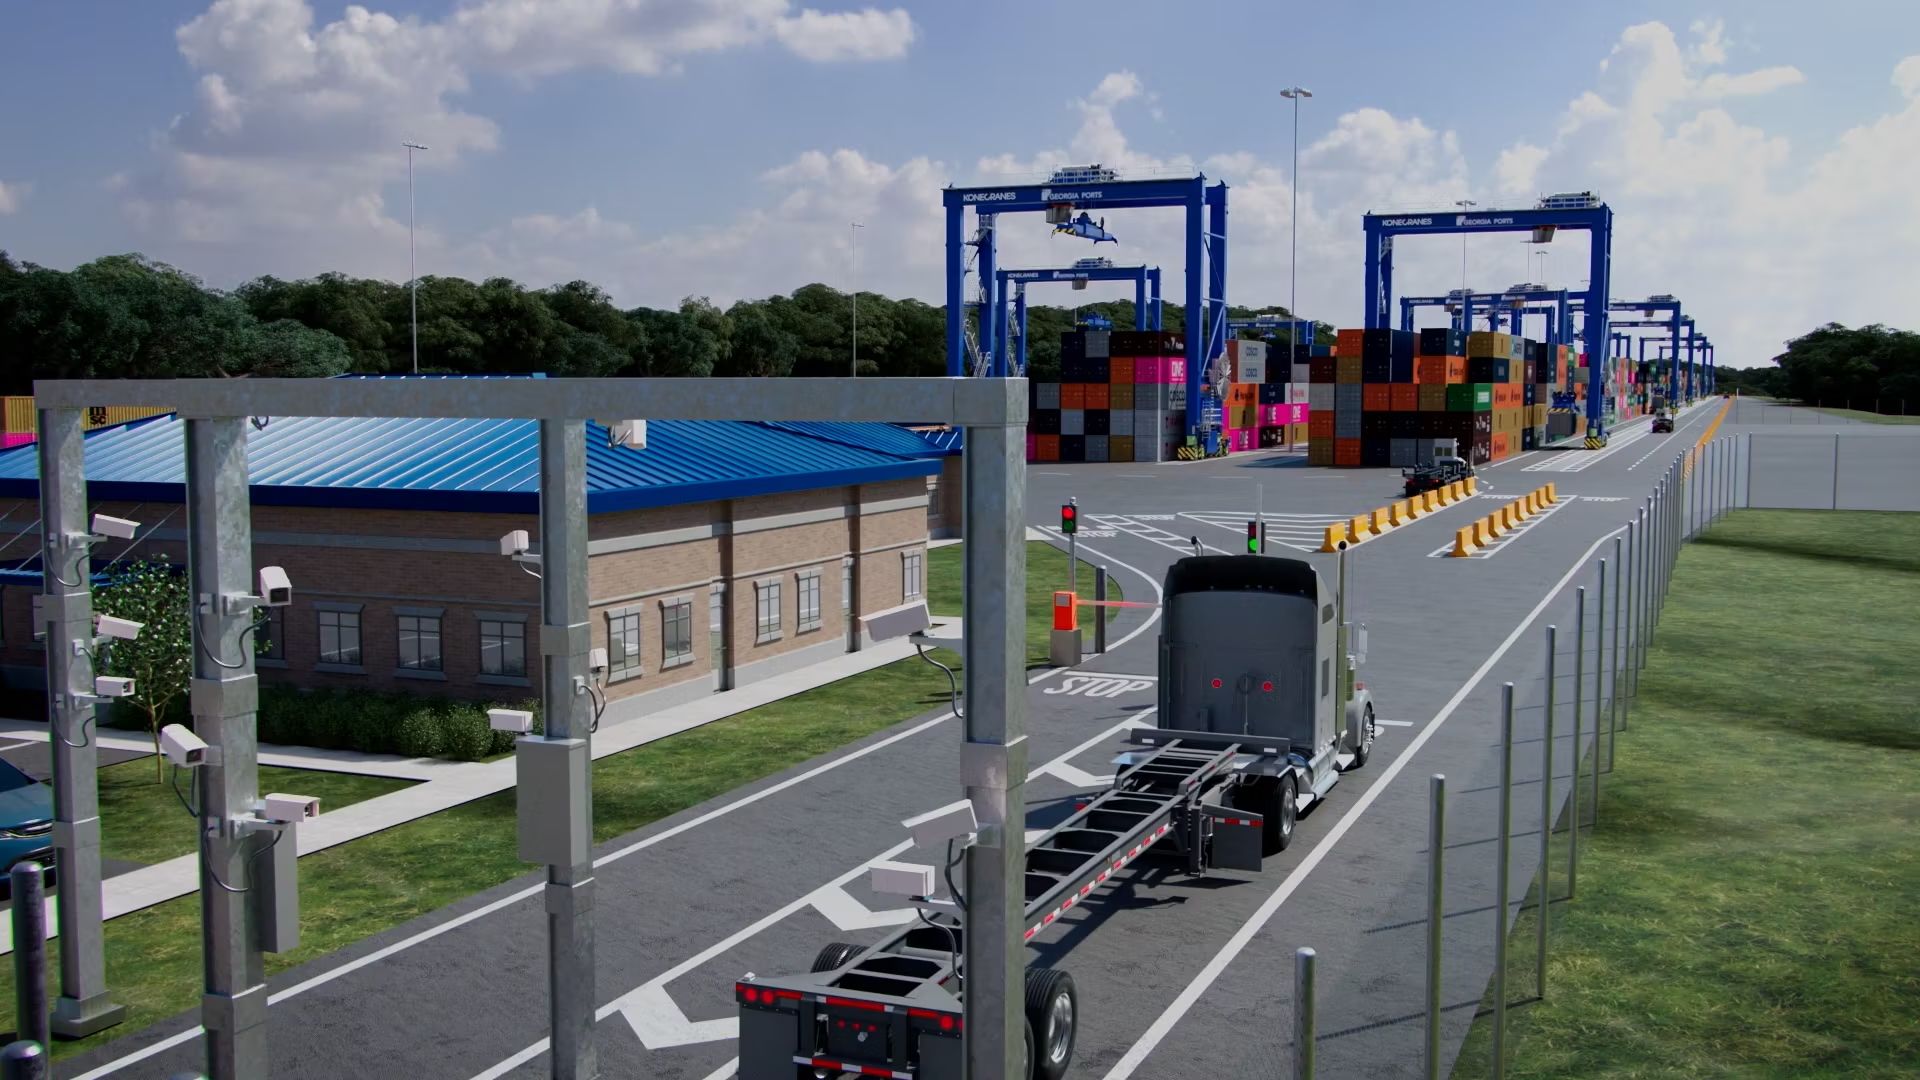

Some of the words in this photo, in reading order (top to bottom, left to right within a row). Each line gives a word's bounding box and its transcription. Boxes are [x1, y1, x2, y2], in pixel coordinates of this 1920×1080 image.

[963, 192, 1016, 202] KONECRANES
[1049, 192, 1079, 200] GEORGIA
[1081, 191, 1103, 199] PORTS
[1382, 218, 1432, 226] KONECRANES
[1463, 218, 1492, 226] GEORGIA
[1493, 217, 1513, 225] PORTS
[1042, 676, 1154, 698] STOP
